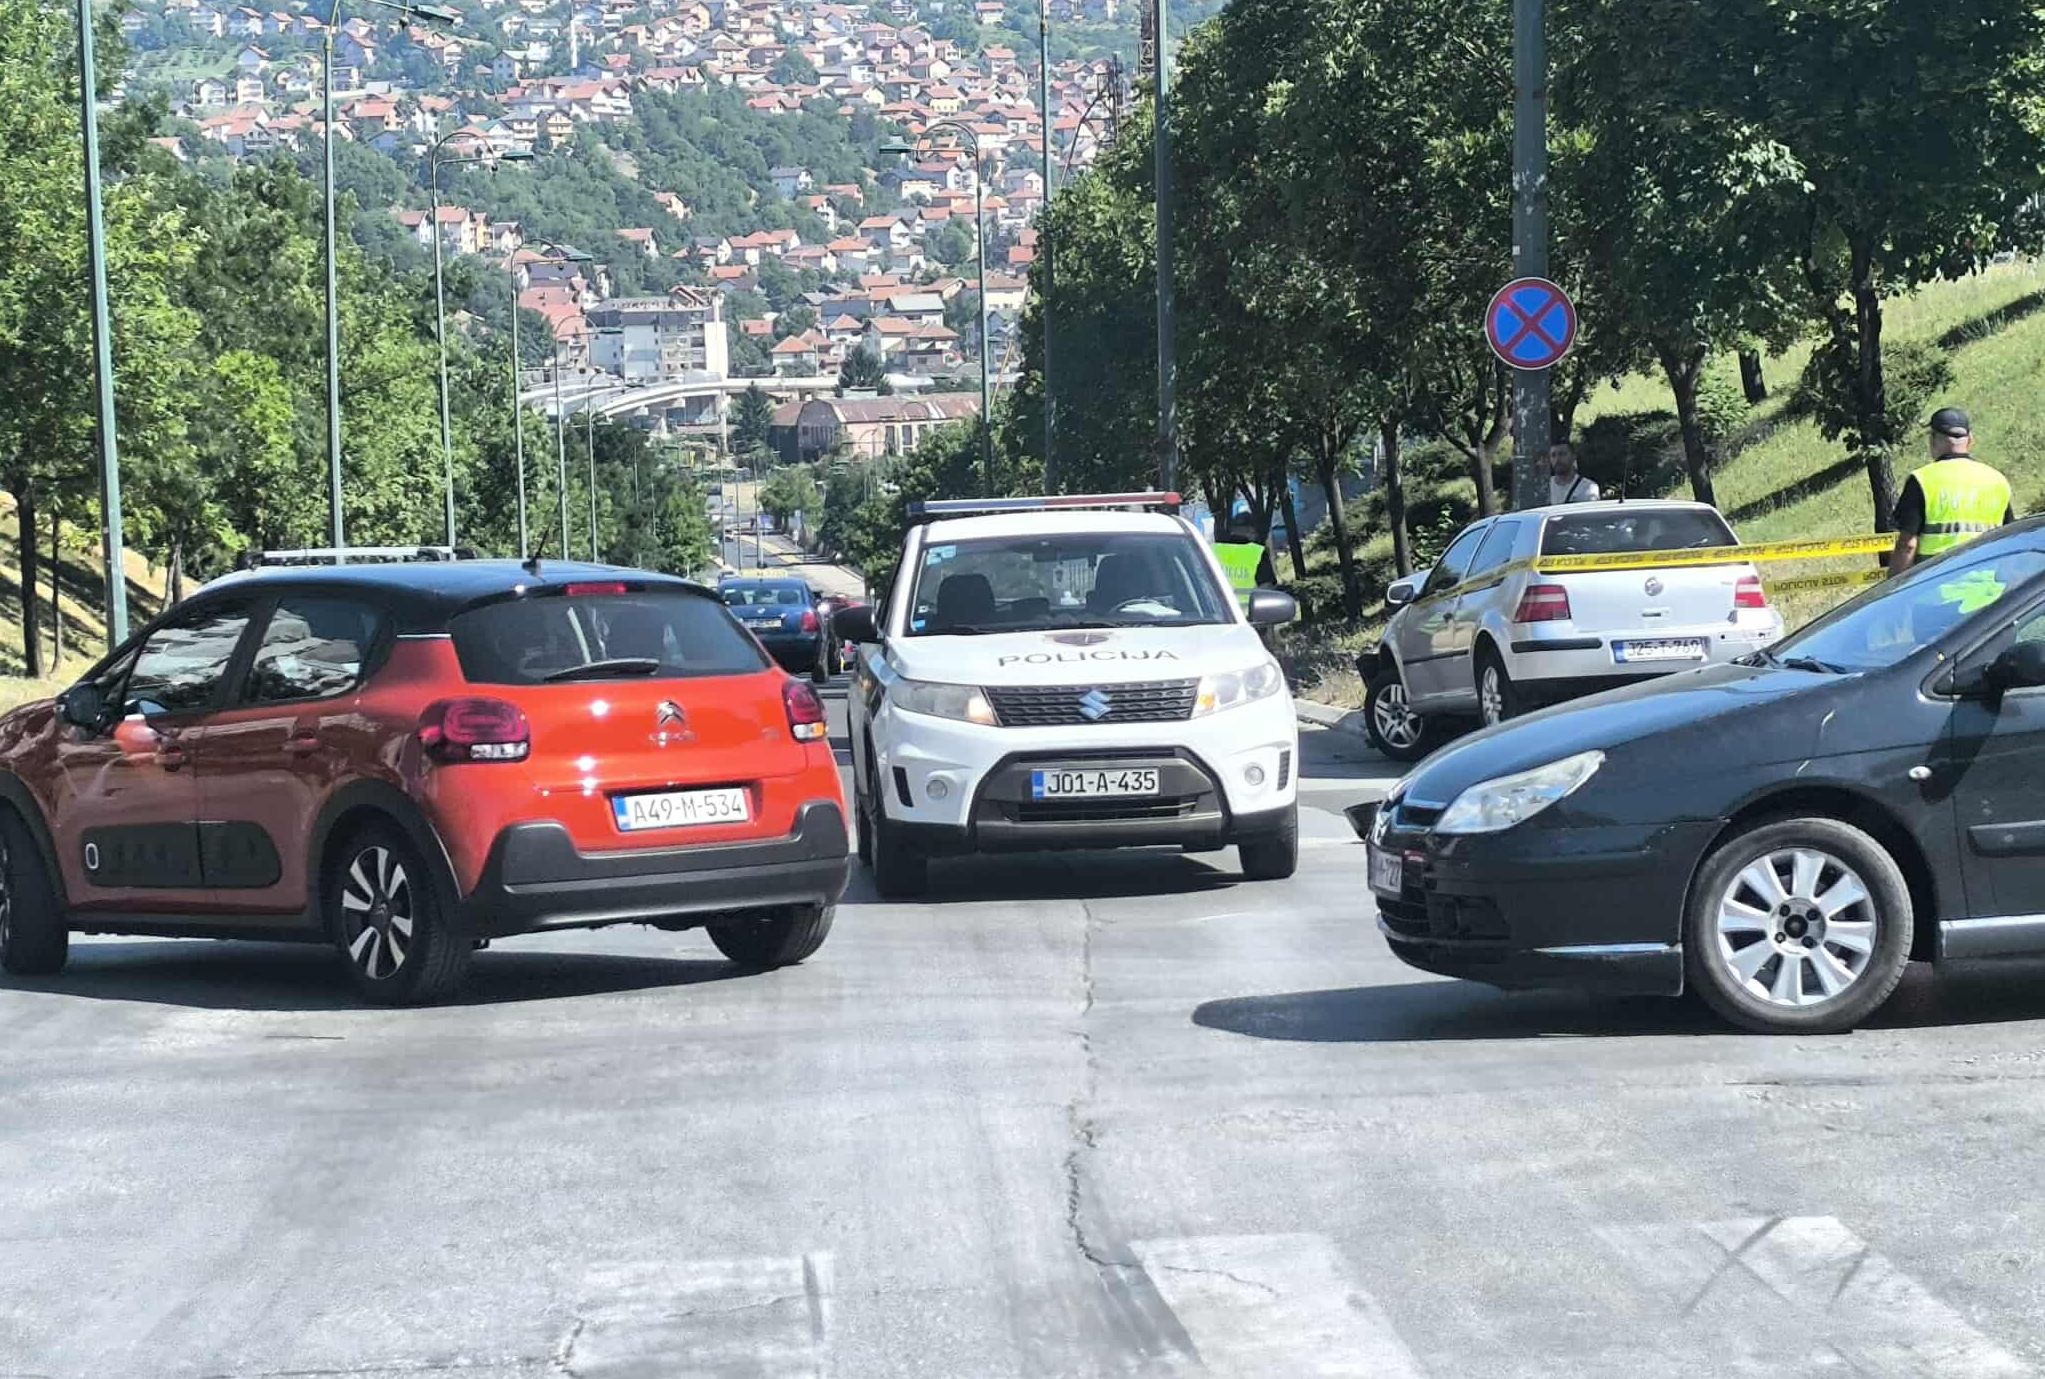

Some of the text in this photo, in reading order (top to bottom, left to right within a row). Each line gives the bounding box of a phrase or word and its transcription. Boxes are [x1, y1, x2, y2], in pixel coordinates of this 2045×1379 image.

[997, 650, 1180, 667] POLICIJA
[1047, 771, 1156, 794] J01-A-435
[634, 794, 742, 824] A49-M-534
